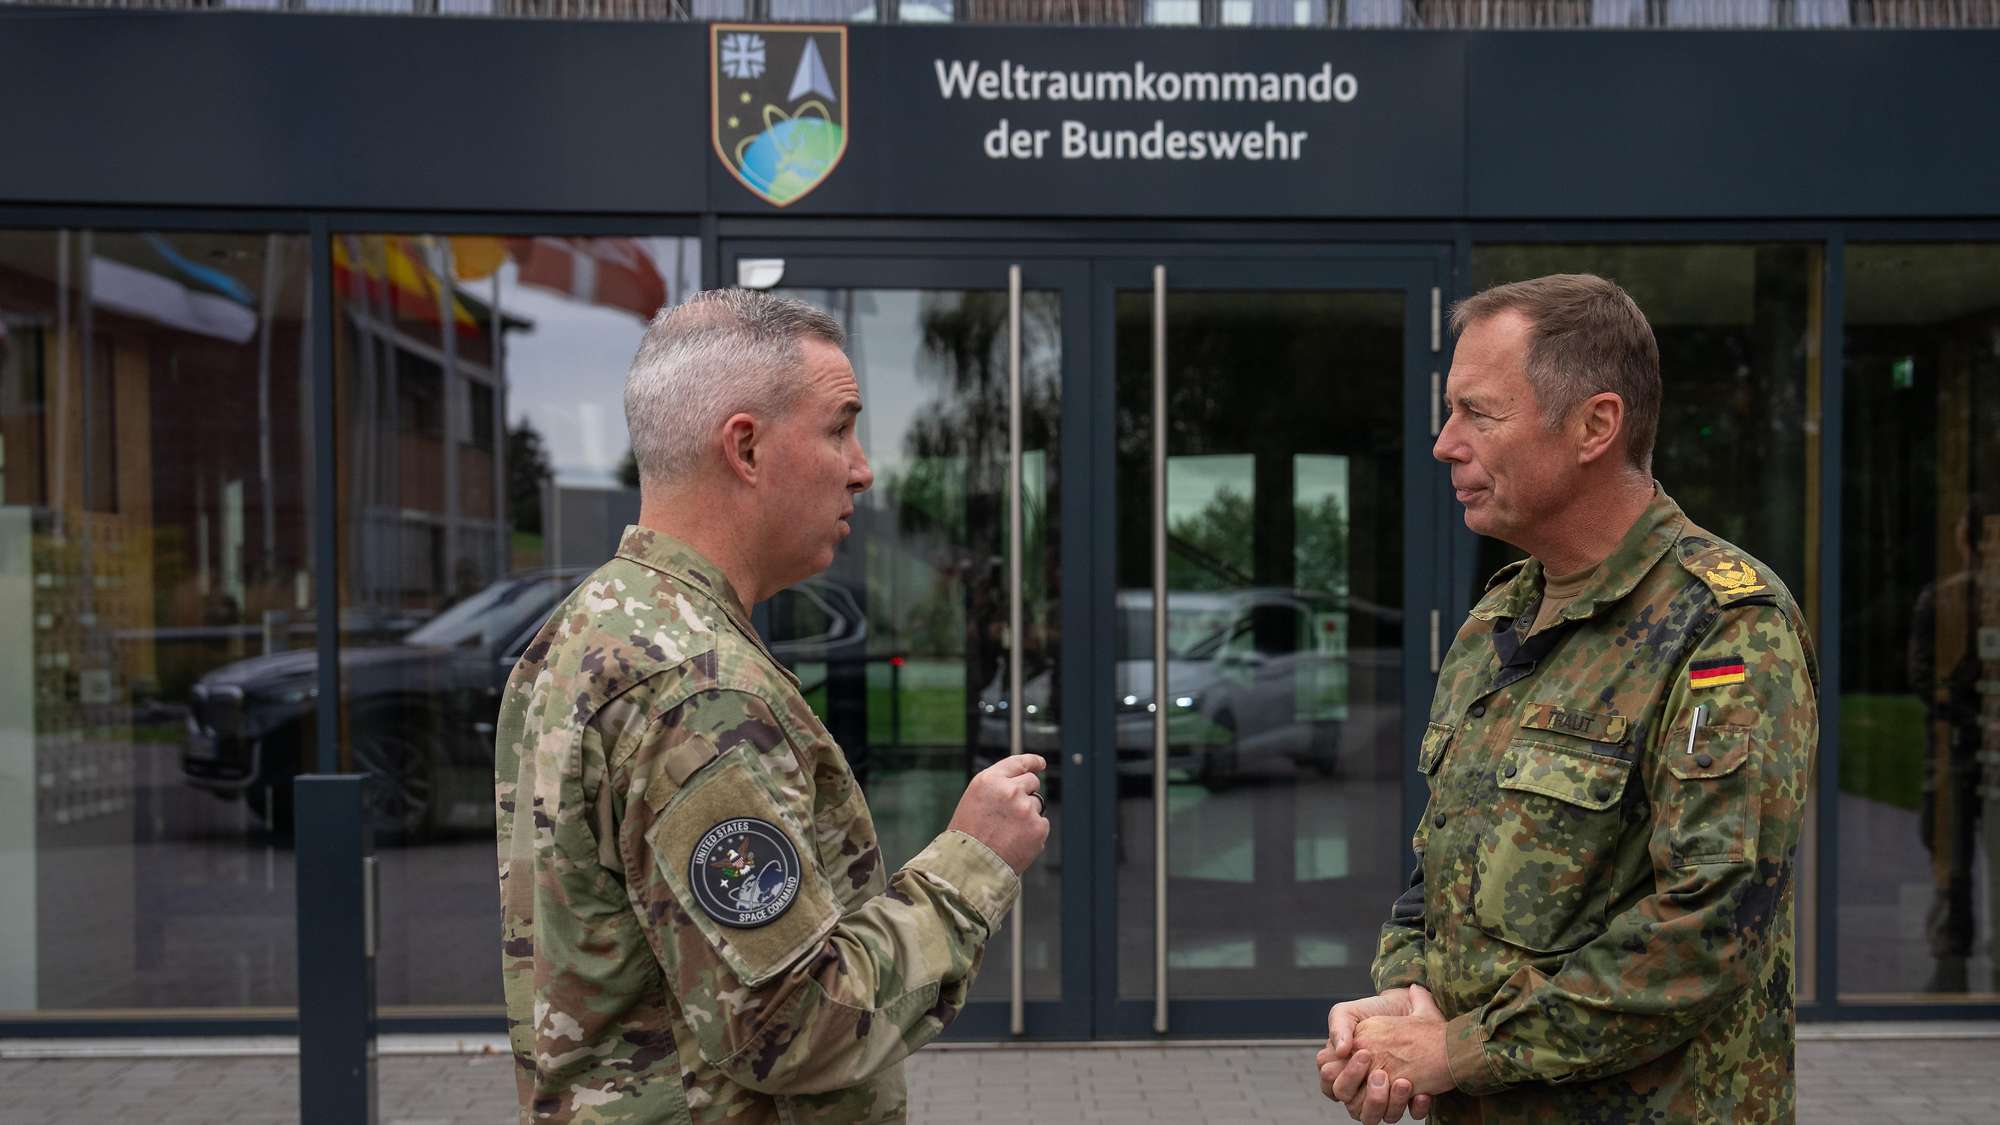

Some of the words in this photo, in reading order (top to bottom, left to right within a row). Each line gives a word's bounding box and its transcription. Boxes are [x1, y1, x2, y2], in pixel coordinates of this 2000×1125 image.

[934, 59, 1358, 101] Weltraumkommando
[984, 119, 1050, 159] der
[1062, 120, 1308, 160] Bundeswehr
[696, 834, 717, 864] UNITED
[716, 822, 749, 837] STATES
[739, 911, 767, 922] SPACE
[767, 876, 797, 914] COMMAND
